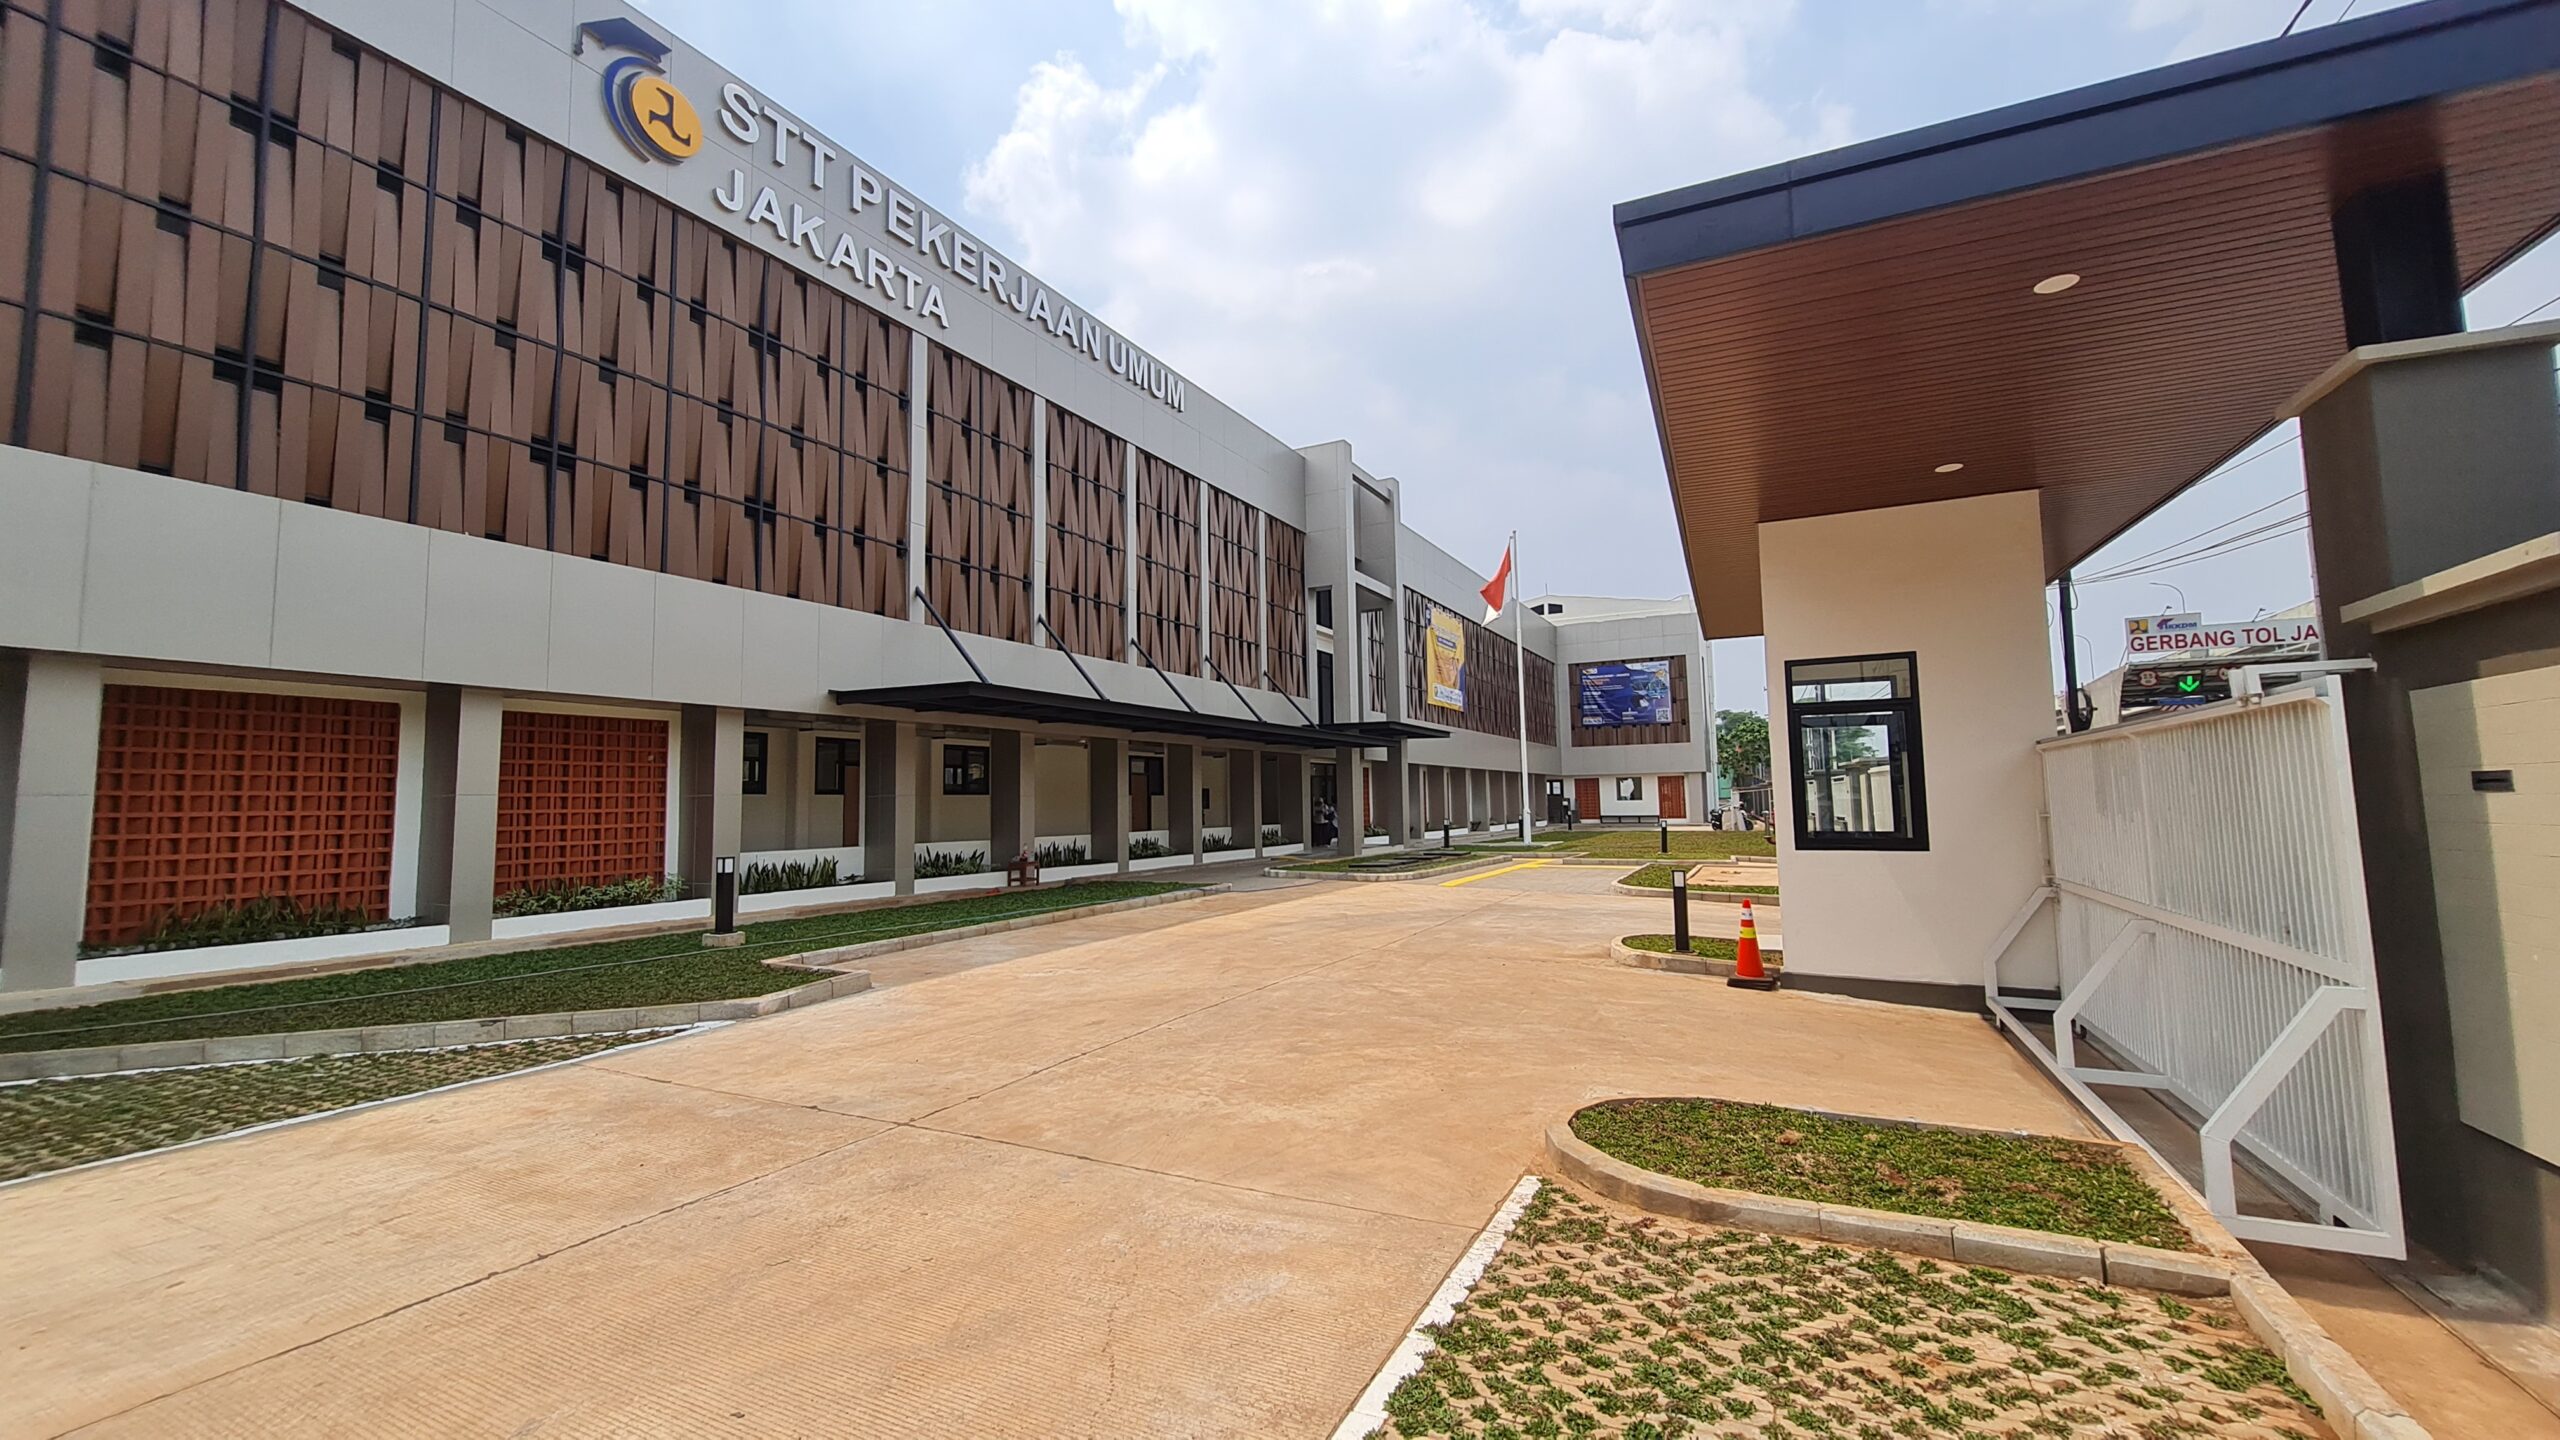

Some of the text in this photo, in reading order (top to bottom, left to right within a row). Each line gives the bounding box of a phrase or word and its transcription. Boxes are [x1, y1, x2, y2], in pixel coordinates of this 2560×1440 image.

[713, 168, 949, 329] JAKARTA
[718, 82, 1185, 412] STT PEKERJAAN UMUM
[2130, 624, 2319, 652] GERBANG TOL JA
